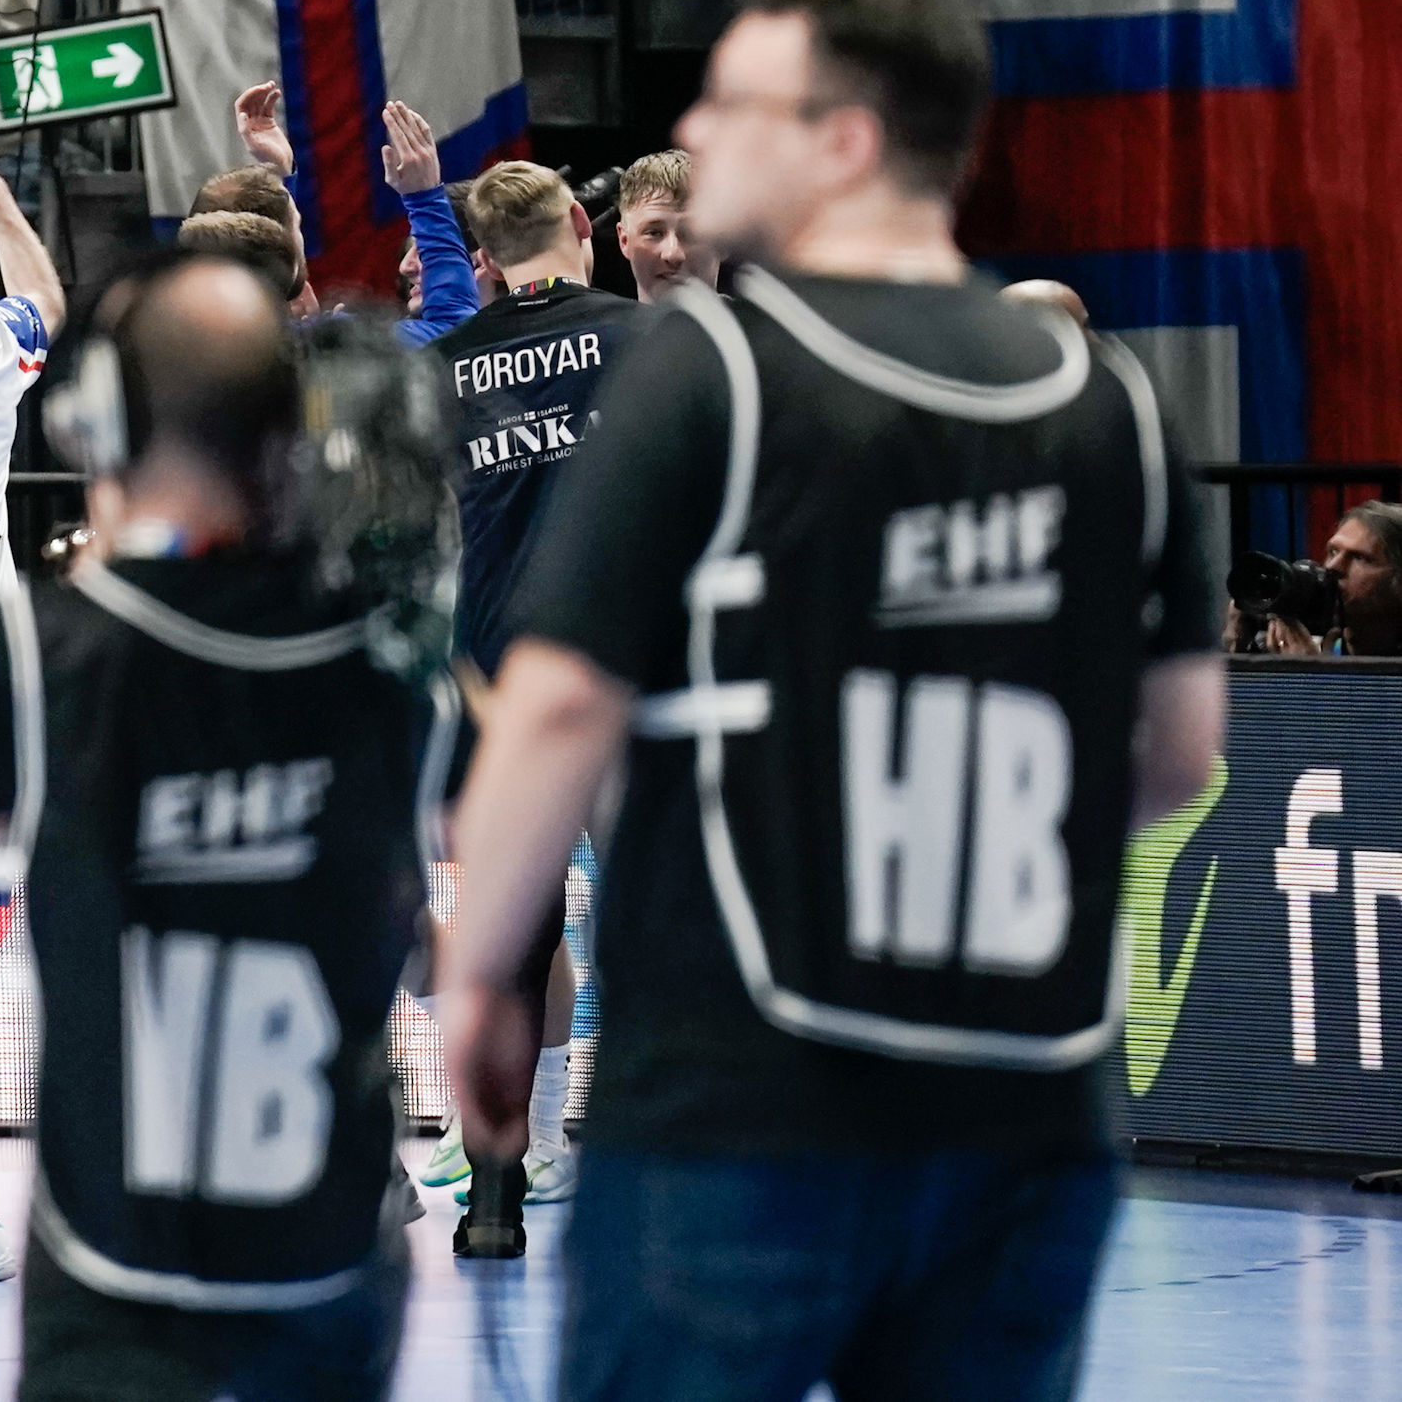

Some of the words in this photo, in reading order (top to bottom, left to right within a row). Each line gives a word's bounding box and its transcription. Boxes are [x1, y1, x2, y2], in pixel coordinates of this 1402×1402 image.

[453, 333, 602, 398] FØROYAR
[883, 485, 1067, 590] EHF
[138, 756, 335, 851] EHF
[839, 668, 1075, 977] HB
